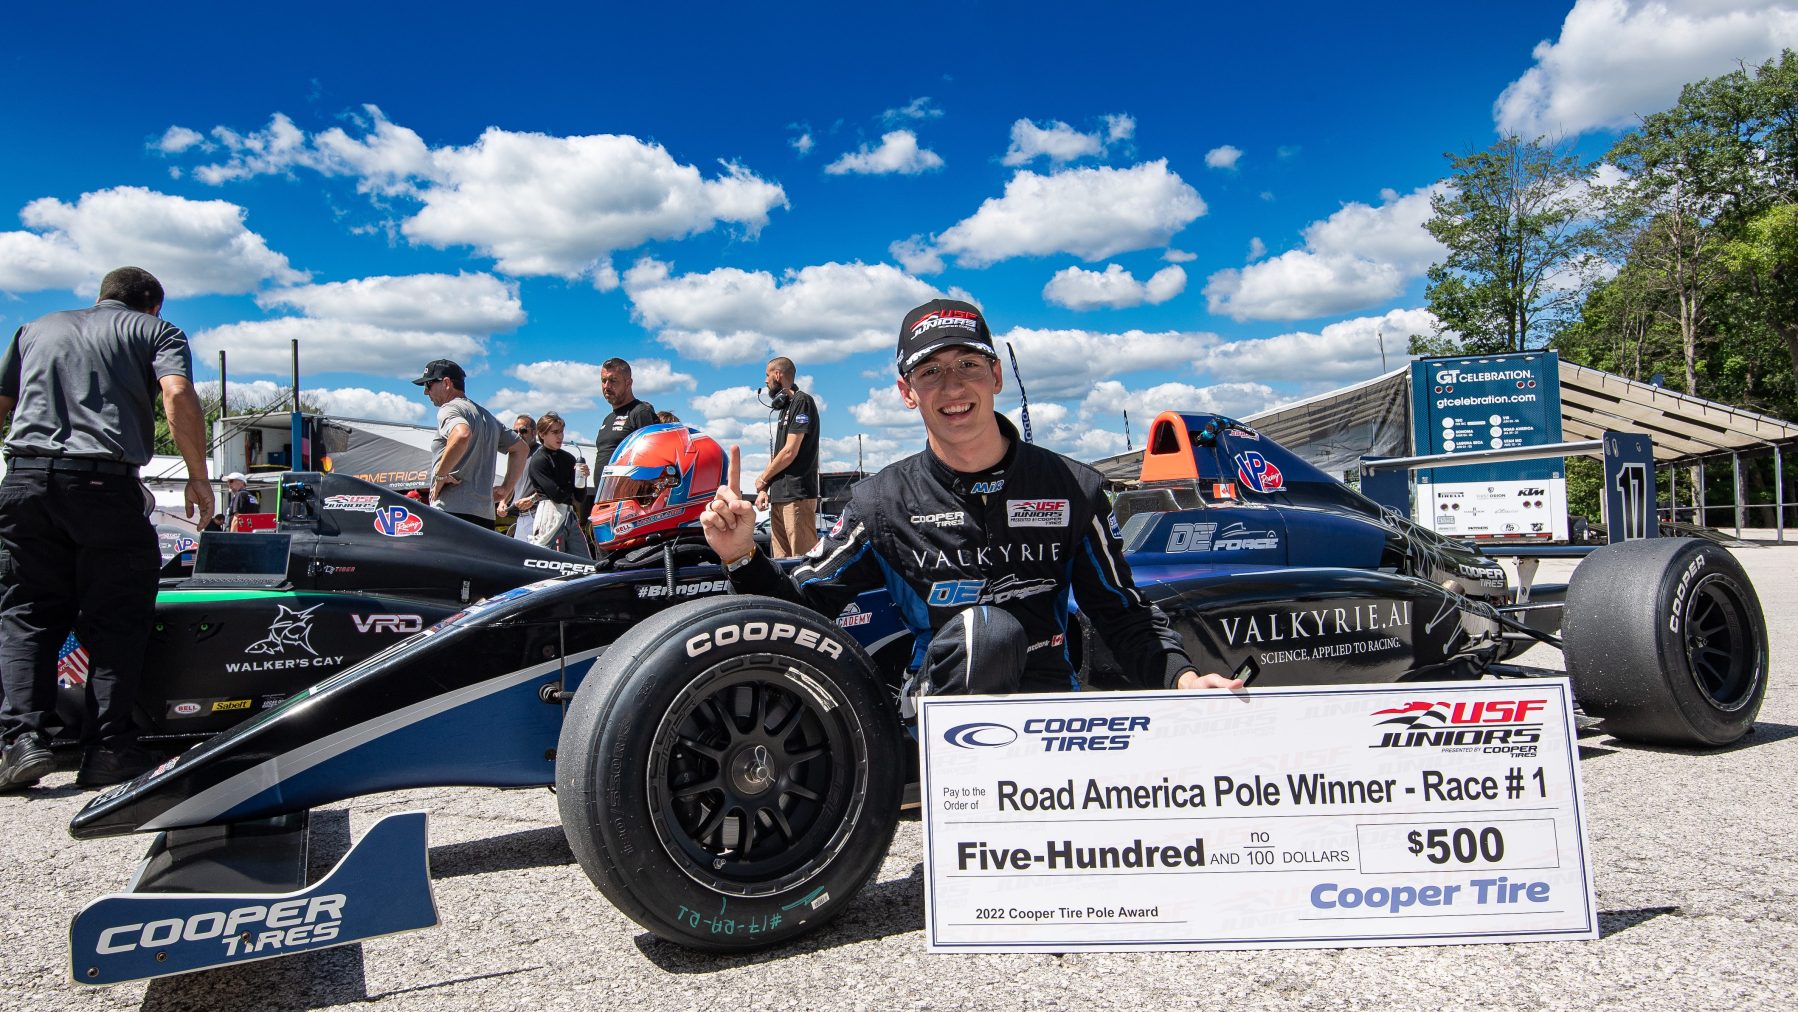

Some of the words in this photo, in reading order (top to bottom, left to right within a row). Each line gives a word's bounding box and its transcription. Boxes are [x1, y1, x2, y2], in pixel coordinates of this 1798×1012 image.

[940, 309, 977, 319] USF
[910, 317, 977, 340] JUNIORS
[1437, 394, 1536, 409] gtcelebration.com
[353, 471, 428, 482] OMETRICS
[1234, 450, 1267, 493] VP
[1517, 488, 1545, 496] KTM
[1035, 502, 1067, 511] USF
[1616, 462, 1647, 541] 17
[376, 505, 409, 536] VP
[910, 512, 965, 524] COOPER
[935, 519, 965, 527] TIRES
[1166, 523, 1218, 553] DE
[1213, 538, 1279, 551] FORCE
[912, 543, 1061, 568] VALKYRIE
[524, 559, 596, 573] COOPER
[1458, 564, 1504, 579] COOPER
[638, 580, 729, 597] #BrngDE
[1480, 579, 1504, 588] TIRES
[1670, 554, 1705, 633] COOPER
[351, 614, 423, 633] VRD
[1219, 601, 1410, 645] VALKYRIE.AI
[685, 622, 844, 660] COOPER
[1260, 648, 1310, 665] SCIENCE,
[1312, 644, 1352, 660] APPLIED
[1353, 642, 1366, 654] TO
[1368, 637, 1401, 652] RACING.
[225, 659, 309, 673] WALKER'S
[313, 656, 344, 666] CAY
[216, 701, 247, 710] Sabelt
[1451, 700, 1548, 724] USF
[1023, 717, 1151, 734] COOPER
[1040, 735, 1131, 752] TIRES
[1369, 728, 1542, 748] JUNIORS
[1483, 745, 1538, 754] COOPER
[943, 787, 959, 798] Pay
[962, 788, 970, 796] to
[972, 787, 986, 796] the
[998, 778, 1075, 811] Road
[1082, 777, 1206, 811] America
[1214, 774, 1280, 807] Pole
[1287, 773, 1396, 805] Winner
[1405, 786, 1415, 794] -
[1422, 769, 1498, 802] Race
[1505, 767, 1525, 799] #
[1532, 766, 1546, 798] 1
[943, 800, 969, 811] Order
[970, 800, 979, 810] of
[1250, 832, 1270, 843] no
[1407, 826, 1505, 865] $500
[957, 838, 1205, 870] Five-Hundred
[1210, 853, 1240, 865] AND
[1246, 851, 1275, 865] 100
[1283, 850, 1350, 865] DOLLARS
[1310, 882, 1461, 913] Cooper
[1470, 876, 1550, 904] Tire
[975, 908, 1006, 919] 2022
[1008, 907, 1056, 921] Cooper
[1058, 907, 1084, 918] Tire
[1086, 907, 1115, 918] Pole
[1117, 906, 1159, 918] Award
[96, 893, 347, 954] COOPER
[222, 920, 342, 956] TIRES
